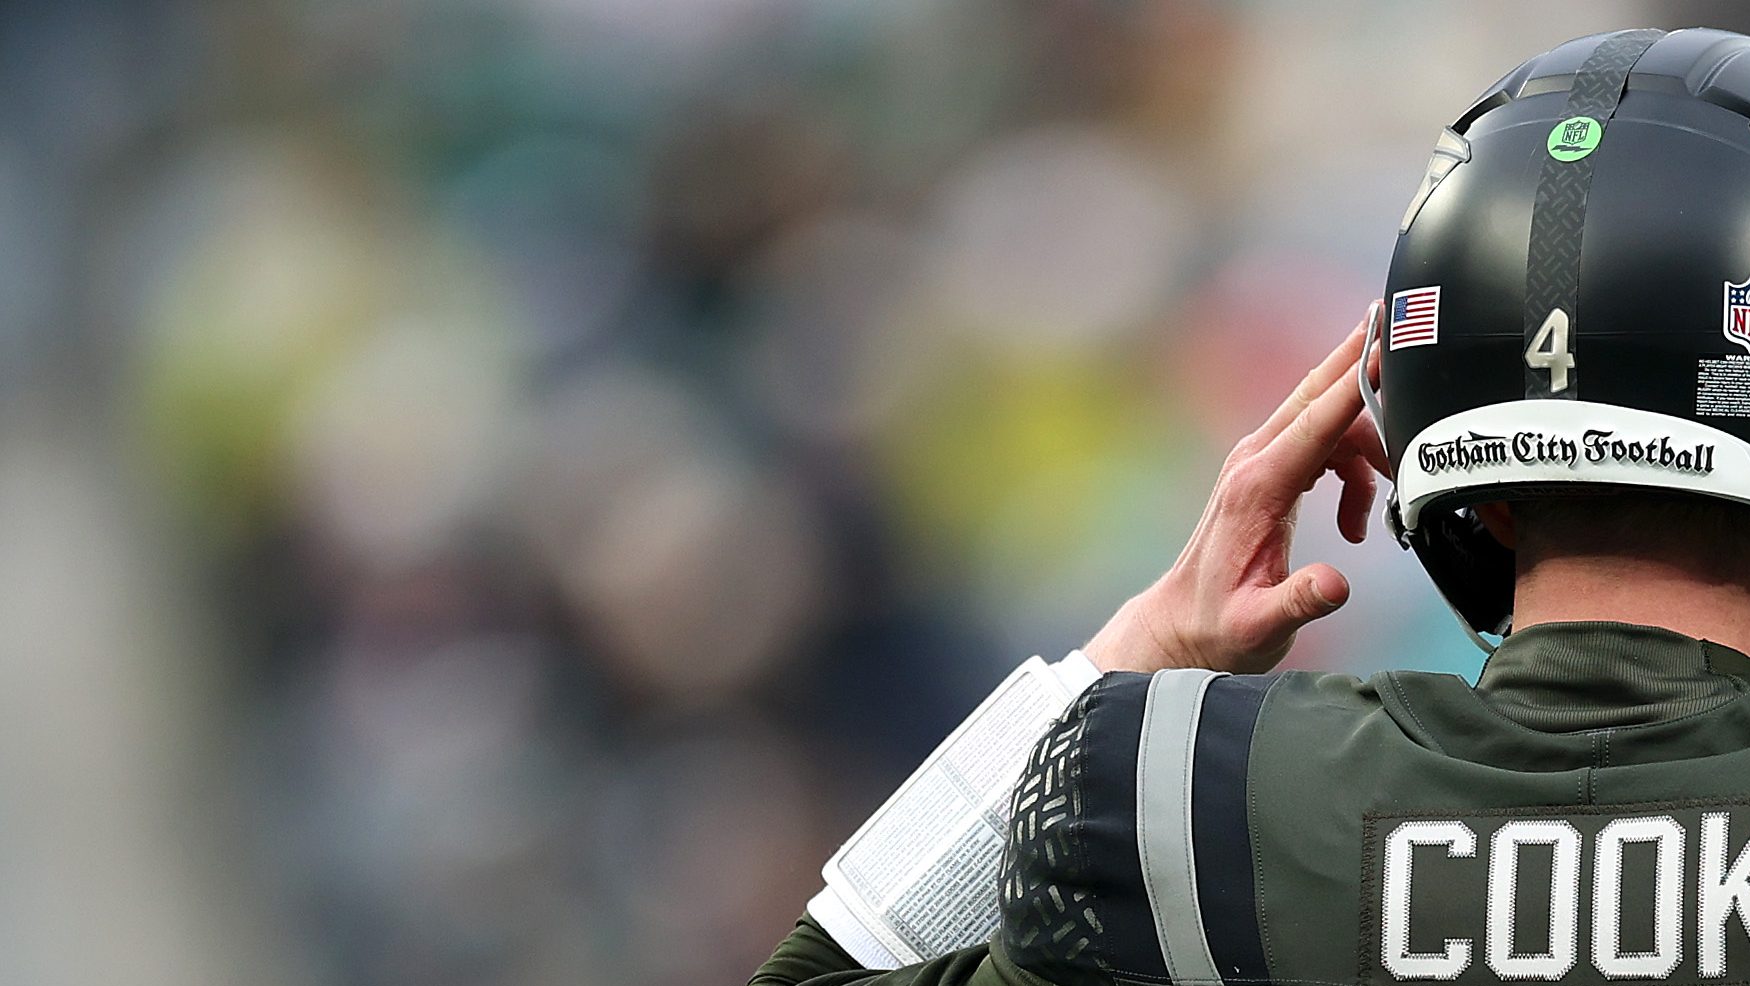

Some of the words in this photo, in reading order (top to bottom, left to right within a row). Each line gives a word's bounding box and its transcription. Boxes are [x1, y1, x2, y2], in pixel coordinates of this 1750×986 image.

[1524, 307, 1575, 393] 4
[1418, 431, 1507, 473] Gotham
[1512, 432, 1577, 467] City
[1583, 429, 1715, 474] Football
